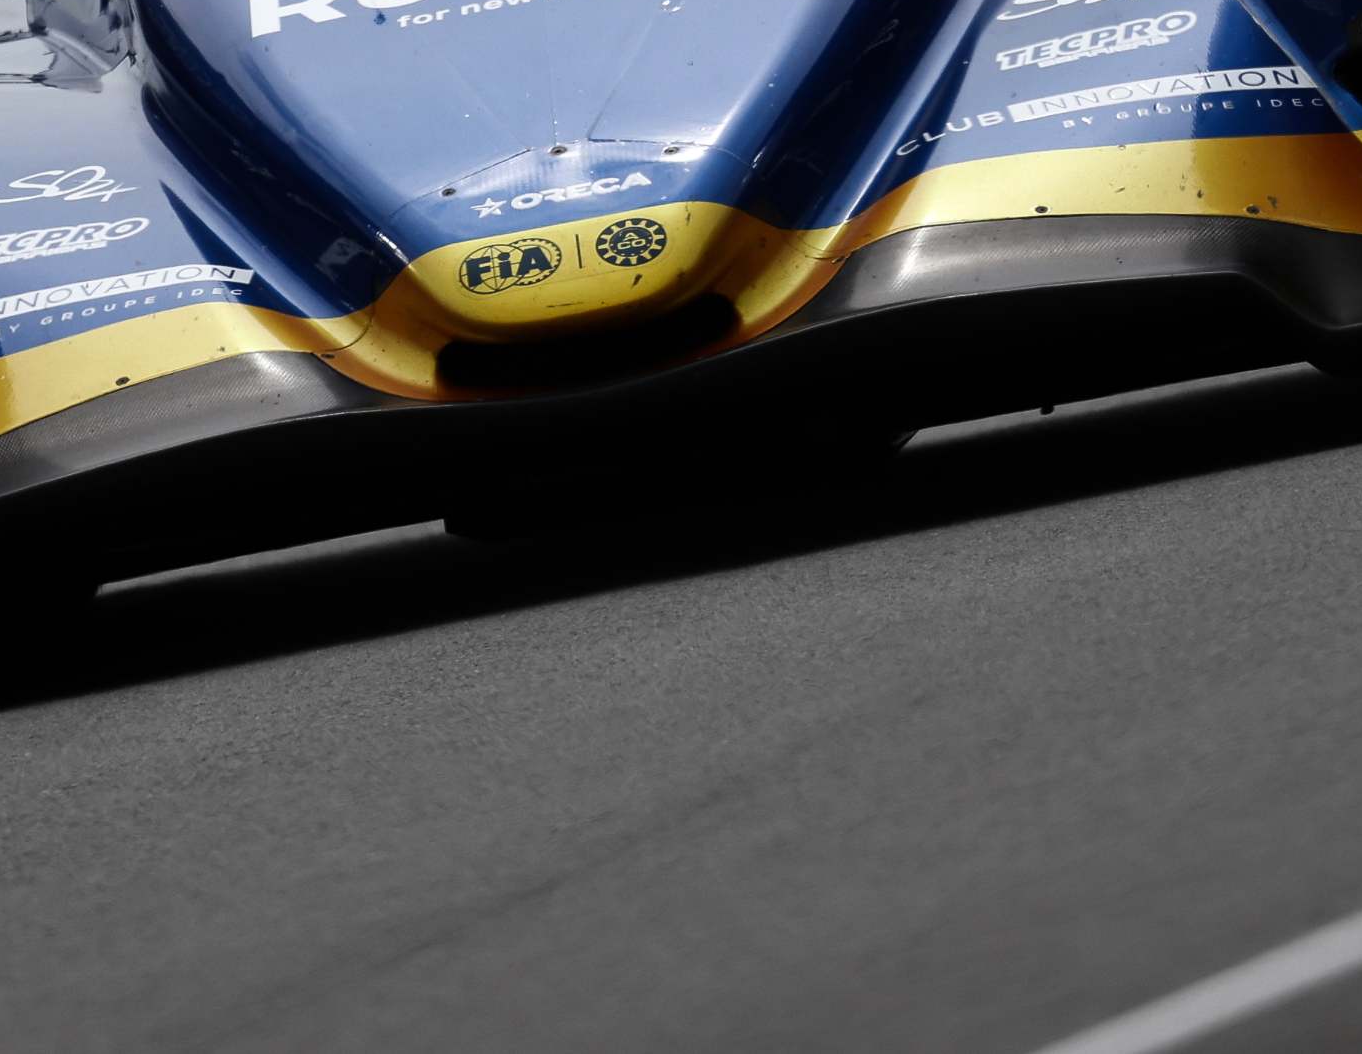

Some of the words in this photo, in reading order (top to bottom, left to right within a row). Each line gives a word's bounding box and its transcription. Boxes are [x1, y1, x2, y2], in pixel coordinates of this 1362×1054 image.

[397, 10, 446, 29] for
[995, 9, 1197, 71] TECPRO
[895, 109, 1005, 157] CLUB
[1027, 68, 1299, 116] INNOVATION
[1062, 114, 1094, 129] BY
[1116, 99, 1237, 121] GROUPE
[1256, 96, 1325, 108] IDEC
[510, 172, 653, 211] ORECA
[40, 295, 157, 327] GROUPE
[175, 287, 245, 300] IDEC
